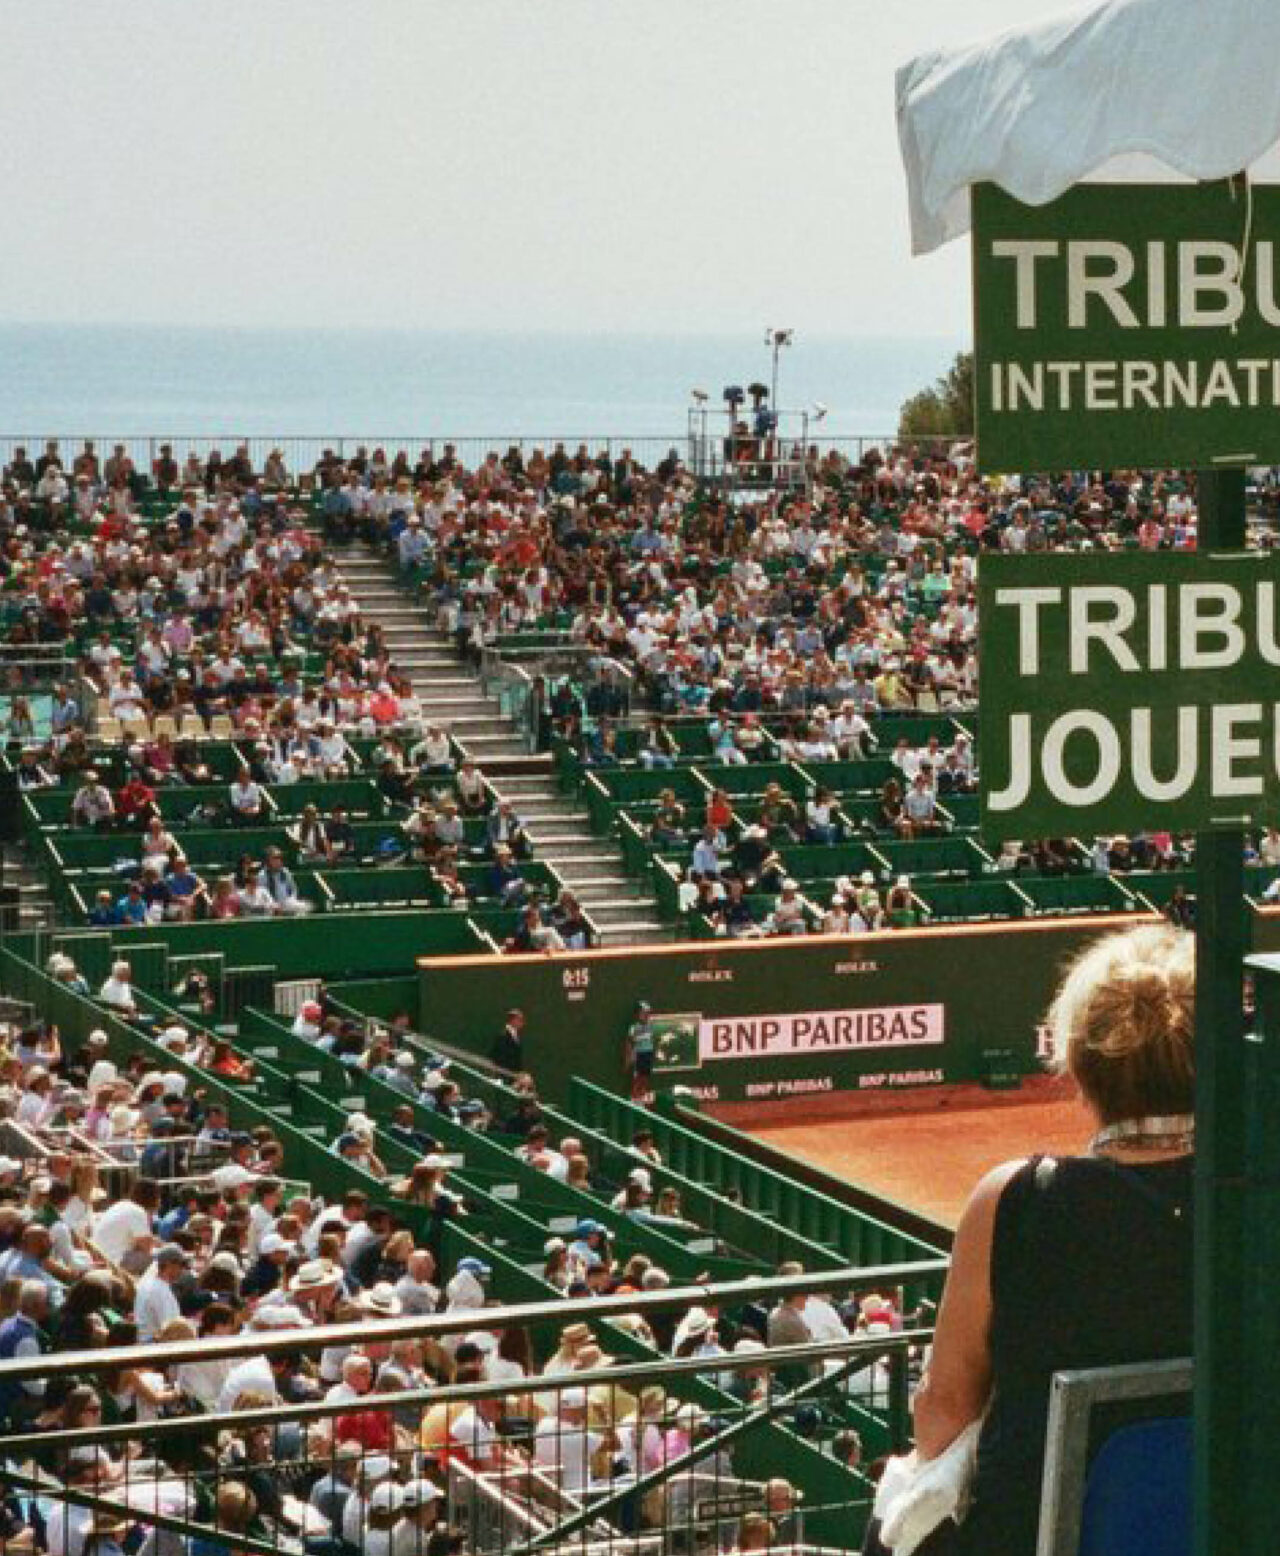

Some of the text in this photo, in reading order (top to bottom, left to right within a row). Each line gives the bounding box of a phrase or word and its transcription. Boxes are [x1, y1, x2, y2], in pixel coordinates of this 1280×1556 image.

[711, 1010, 929, 1054] BNP PARIBAS
[745, 1076, 833, 1097] BNP PARIBAS
[859, 1067, 944, 1088] BNP PARIBAS
